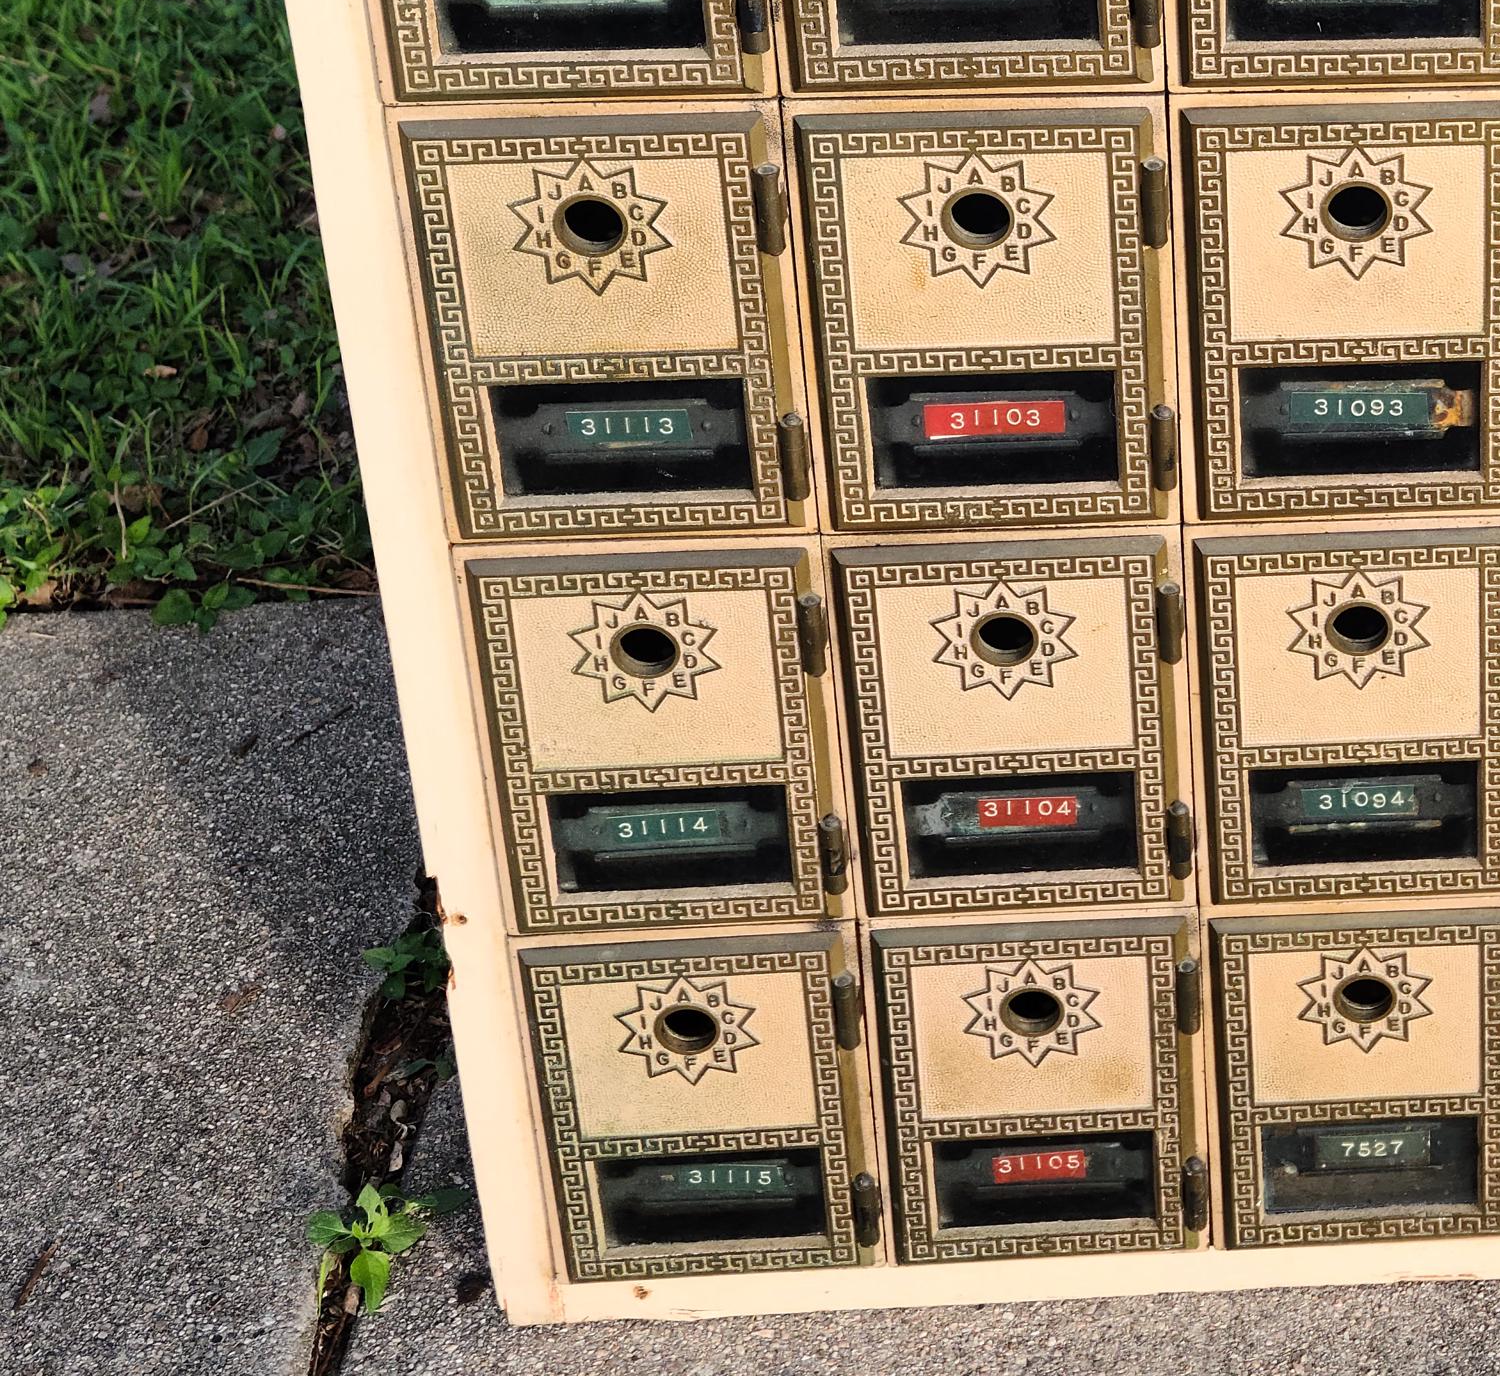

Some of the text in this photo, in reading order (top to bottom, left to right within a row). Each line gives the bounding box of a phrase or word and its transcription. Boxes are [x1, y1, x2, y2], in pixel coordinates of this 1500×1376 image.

[967, 168, 984, 184] A
[938, 178, 951, 193] J
[1001, 176, 1015, 192] B
[1016, 198, 1030, 214] C
[924, 225, 938, 241] H
[1018, 222, 1031, 239] D
[941, 245, 956, 262] G
[1005, 245, 1019, 261] E
[972, 253, 987, 270] F
[1314, 398, 1403, 416] 31093
[581, 417, 673, 435] 31113
[950, 409, 1040, 430] 31103
[1351, 582, 1366, 598] A
[1381, 590, 1395, 604] B
[1323, 591, 1336, 606] J
[1394, 609, 1408, 624] C
[1308, 633, 1321, 648] H
[1395, 631, 1408, 646] D
[1324, 652, 1338, 667] G
[1352, 657, 1366, 672] F
[1381, 650, 1396, 665] E
[1319, 791, 1404, 810] 31094
[985, 801, 1071, 817] 31104
[619, 817, 708, 837] 31114
[677, 989, 690, 1002] A
[707, 994, 720, 1006] B
[651, 997, 662, 1010] J
[722, 1011, 735, 1024] C
[639, 1035, 652, 1049] H
[724, 1033, 737, 1045] D
[656, 1052, 669, 1065] G
[683, 1057, 696, 1070] F
[713, 1049, 726, 1063] E
[1342, 1141, 1403, 1157] 7527
[999, 1155, 1080, 1173] 31105
[689, 1170, 771, 1185] 31115
